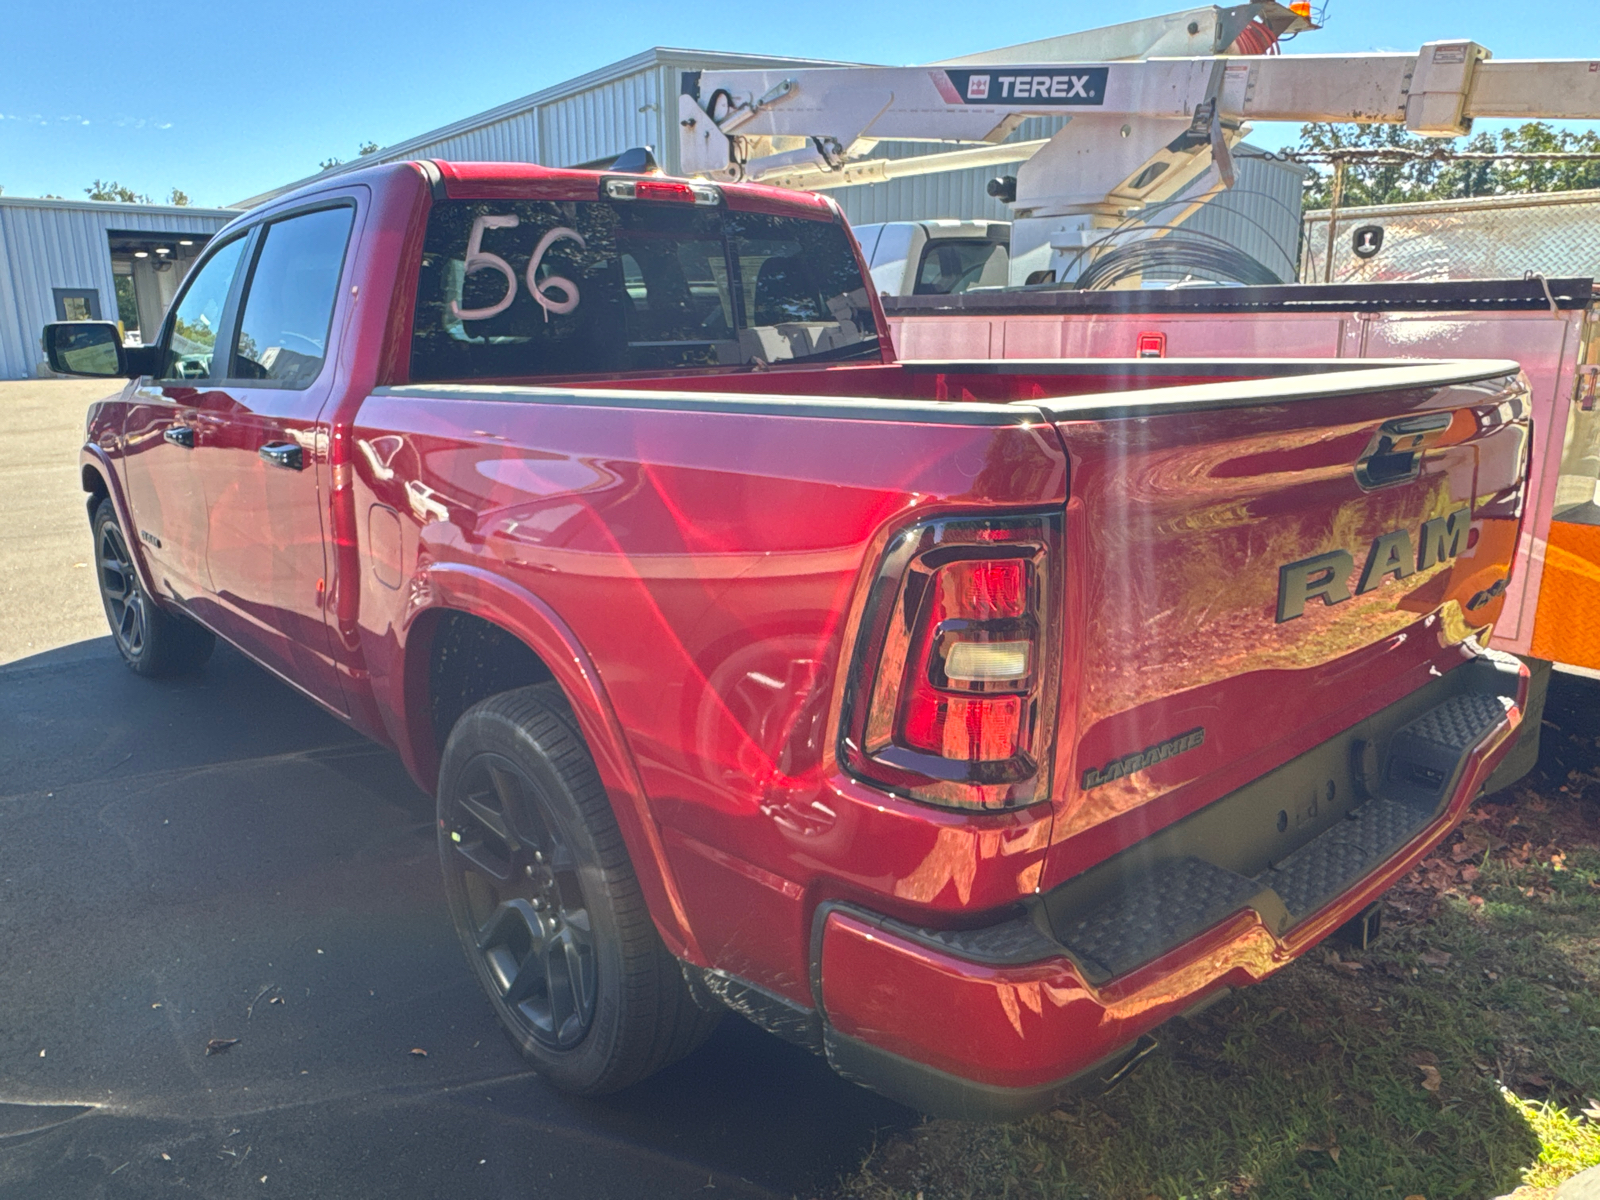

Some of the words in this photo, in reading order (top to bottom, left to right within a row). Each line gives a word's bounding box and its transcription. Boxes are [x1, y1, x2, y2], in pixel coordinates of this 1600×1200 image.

[998, 75, 1090, 98] TEREX
[451, 214, 580, 323] 56
[1275, 508, 1471, 624] RAM
[1081, 726, 1205, 791] LARAMIE
